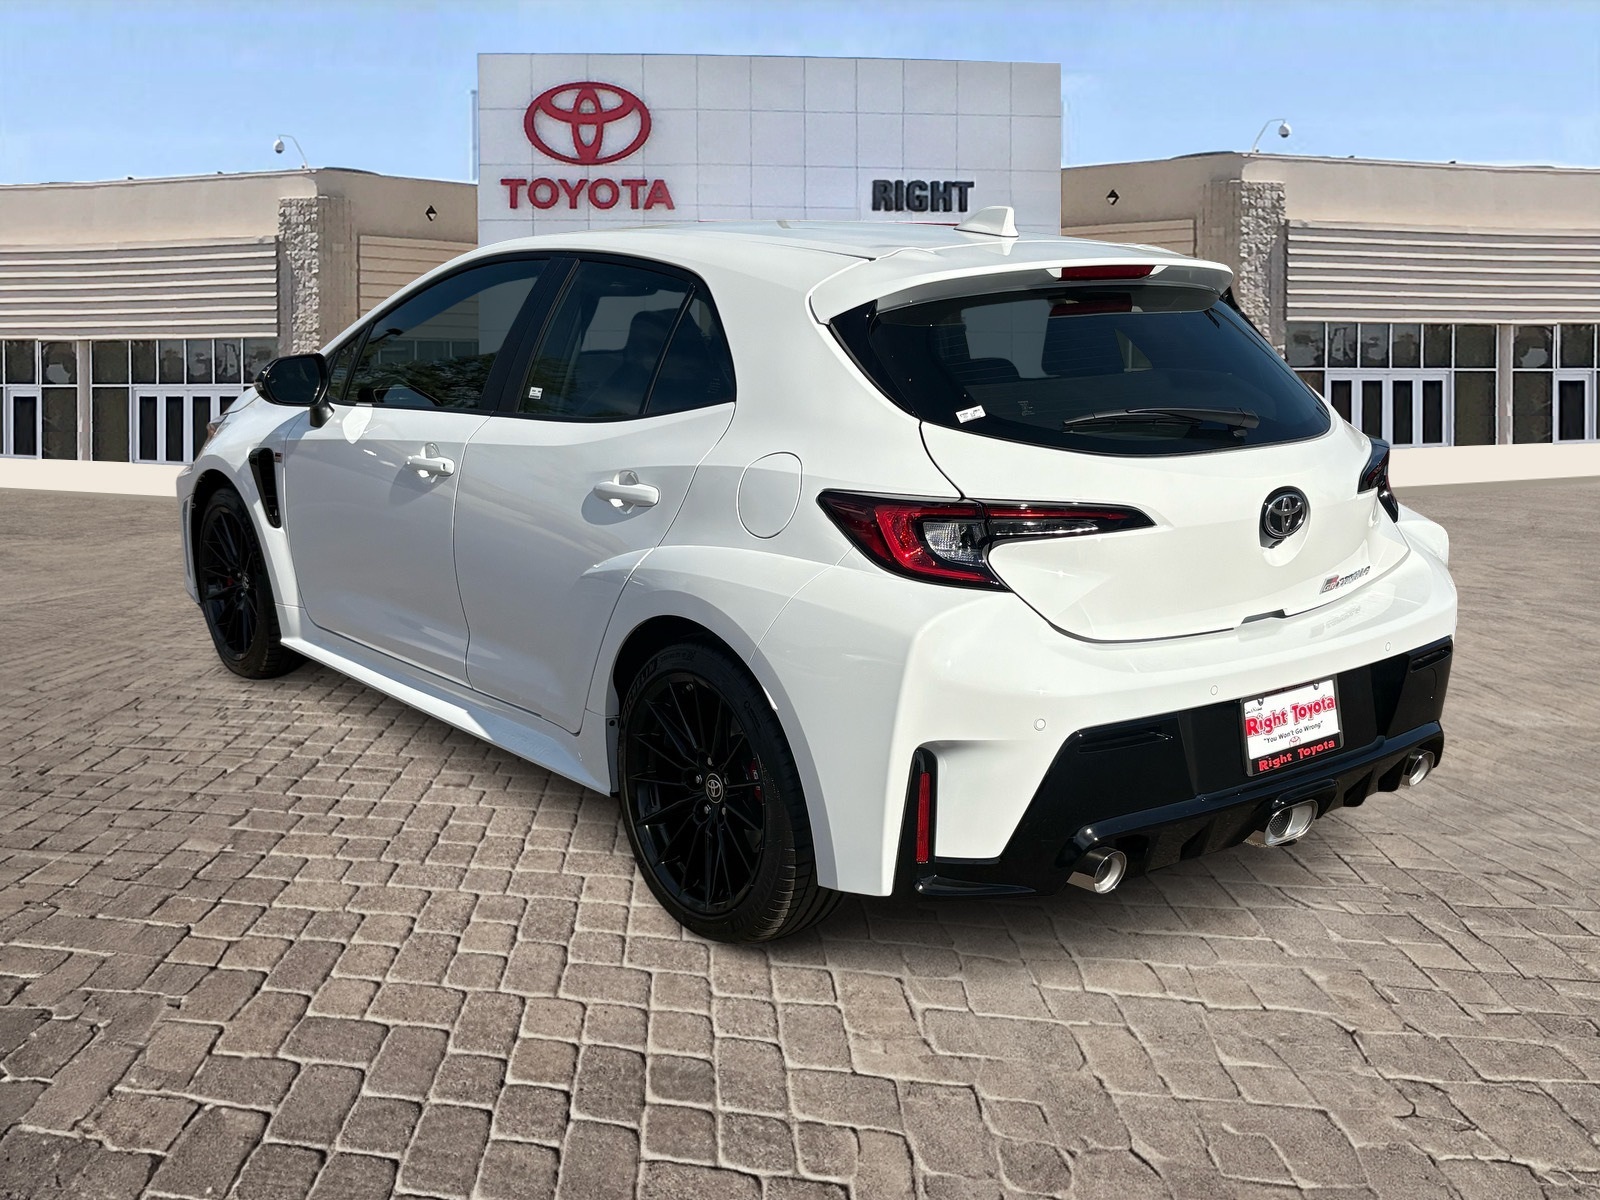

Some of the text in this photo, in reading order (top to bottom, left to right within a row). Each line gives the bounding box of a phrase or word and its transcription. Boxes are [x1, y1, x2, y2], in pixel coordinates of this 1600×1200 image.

[500, 178, 675, 210] TOYOTA
[872, 179, 975, 213] RIGHT
[1245, 695, 1335, 737] Right Toyota
[1278, 730, 1295, 739] Won't
[1259, 740, 1335, 771] Right Toyota
